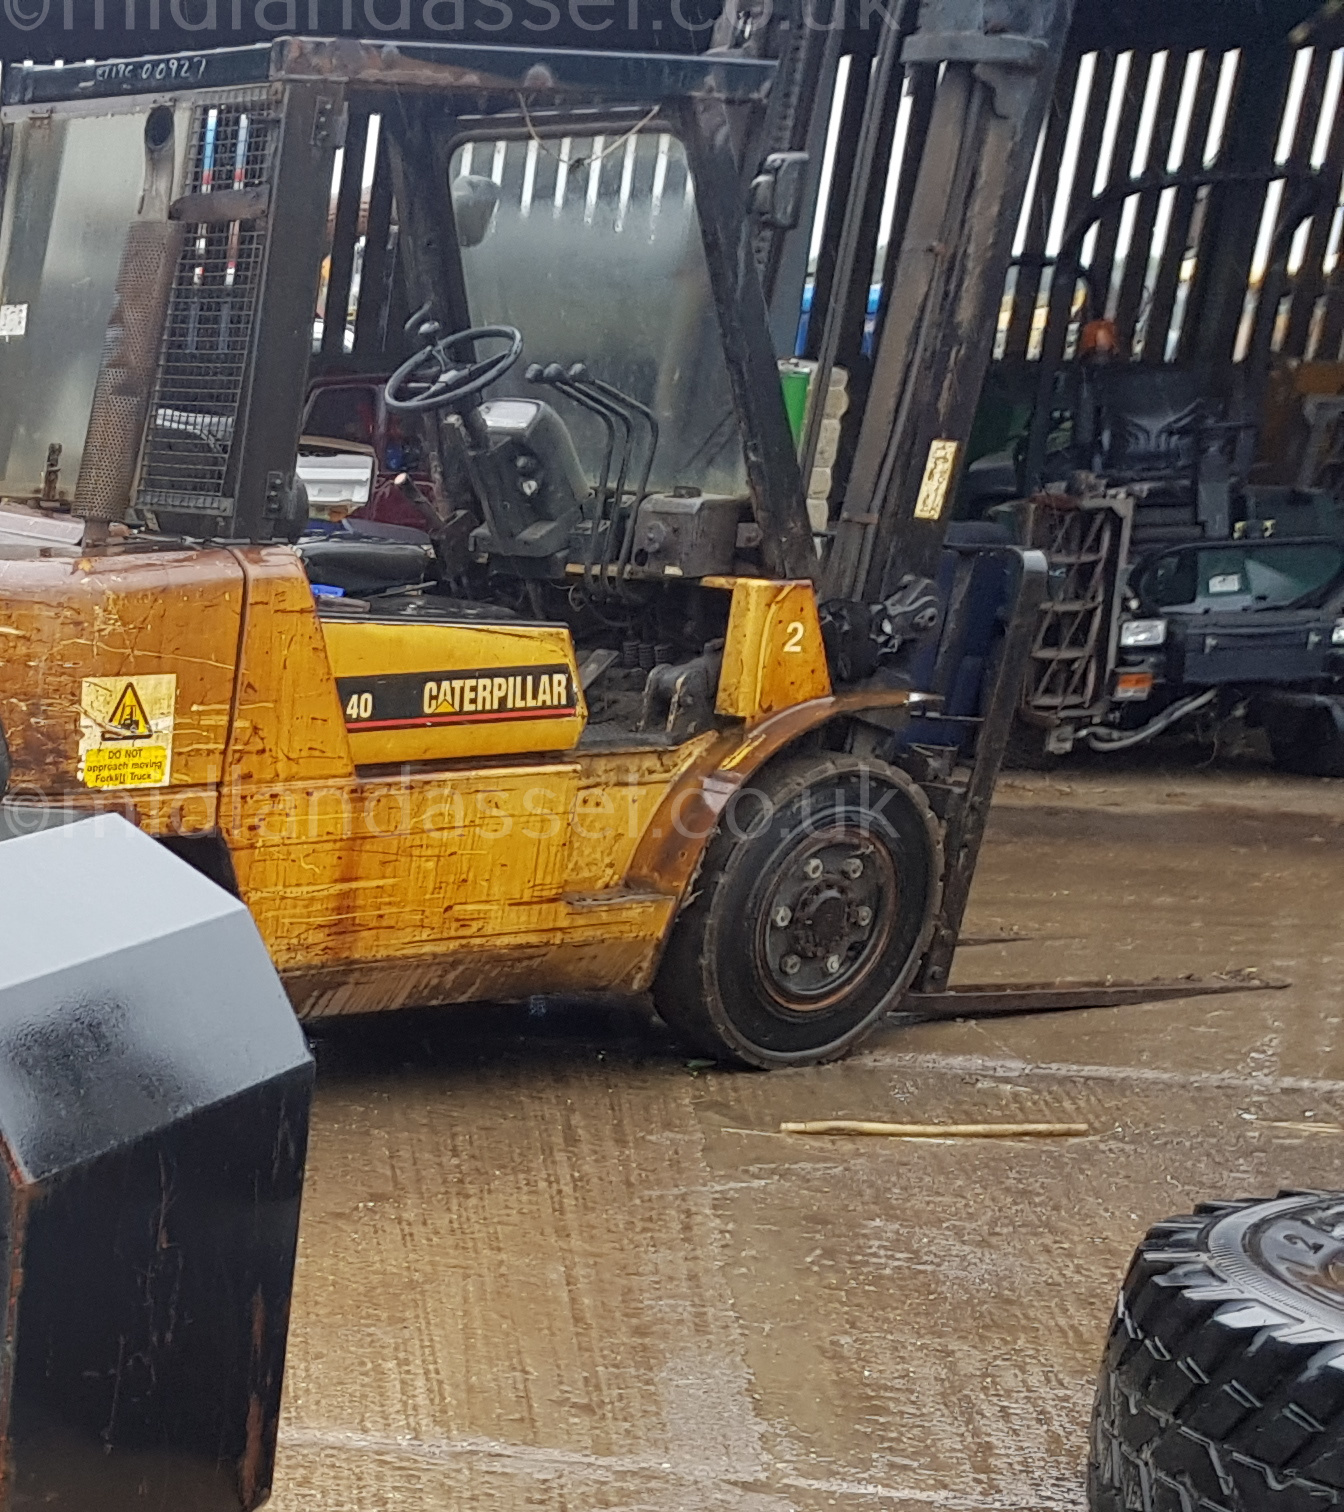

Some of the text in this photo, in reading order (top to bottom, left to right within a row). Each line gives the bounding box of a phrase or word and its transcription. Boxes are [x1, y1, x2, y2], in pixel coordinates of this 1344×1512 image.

[141, 57, 207, 80] 00927
[782, 621, 805, 654] 2
[345, 673, 568, 720] 40 CATERPILLAR
[86, 758, 163, 773] approach moving
[107, 748, 144, 760] DO NOT
